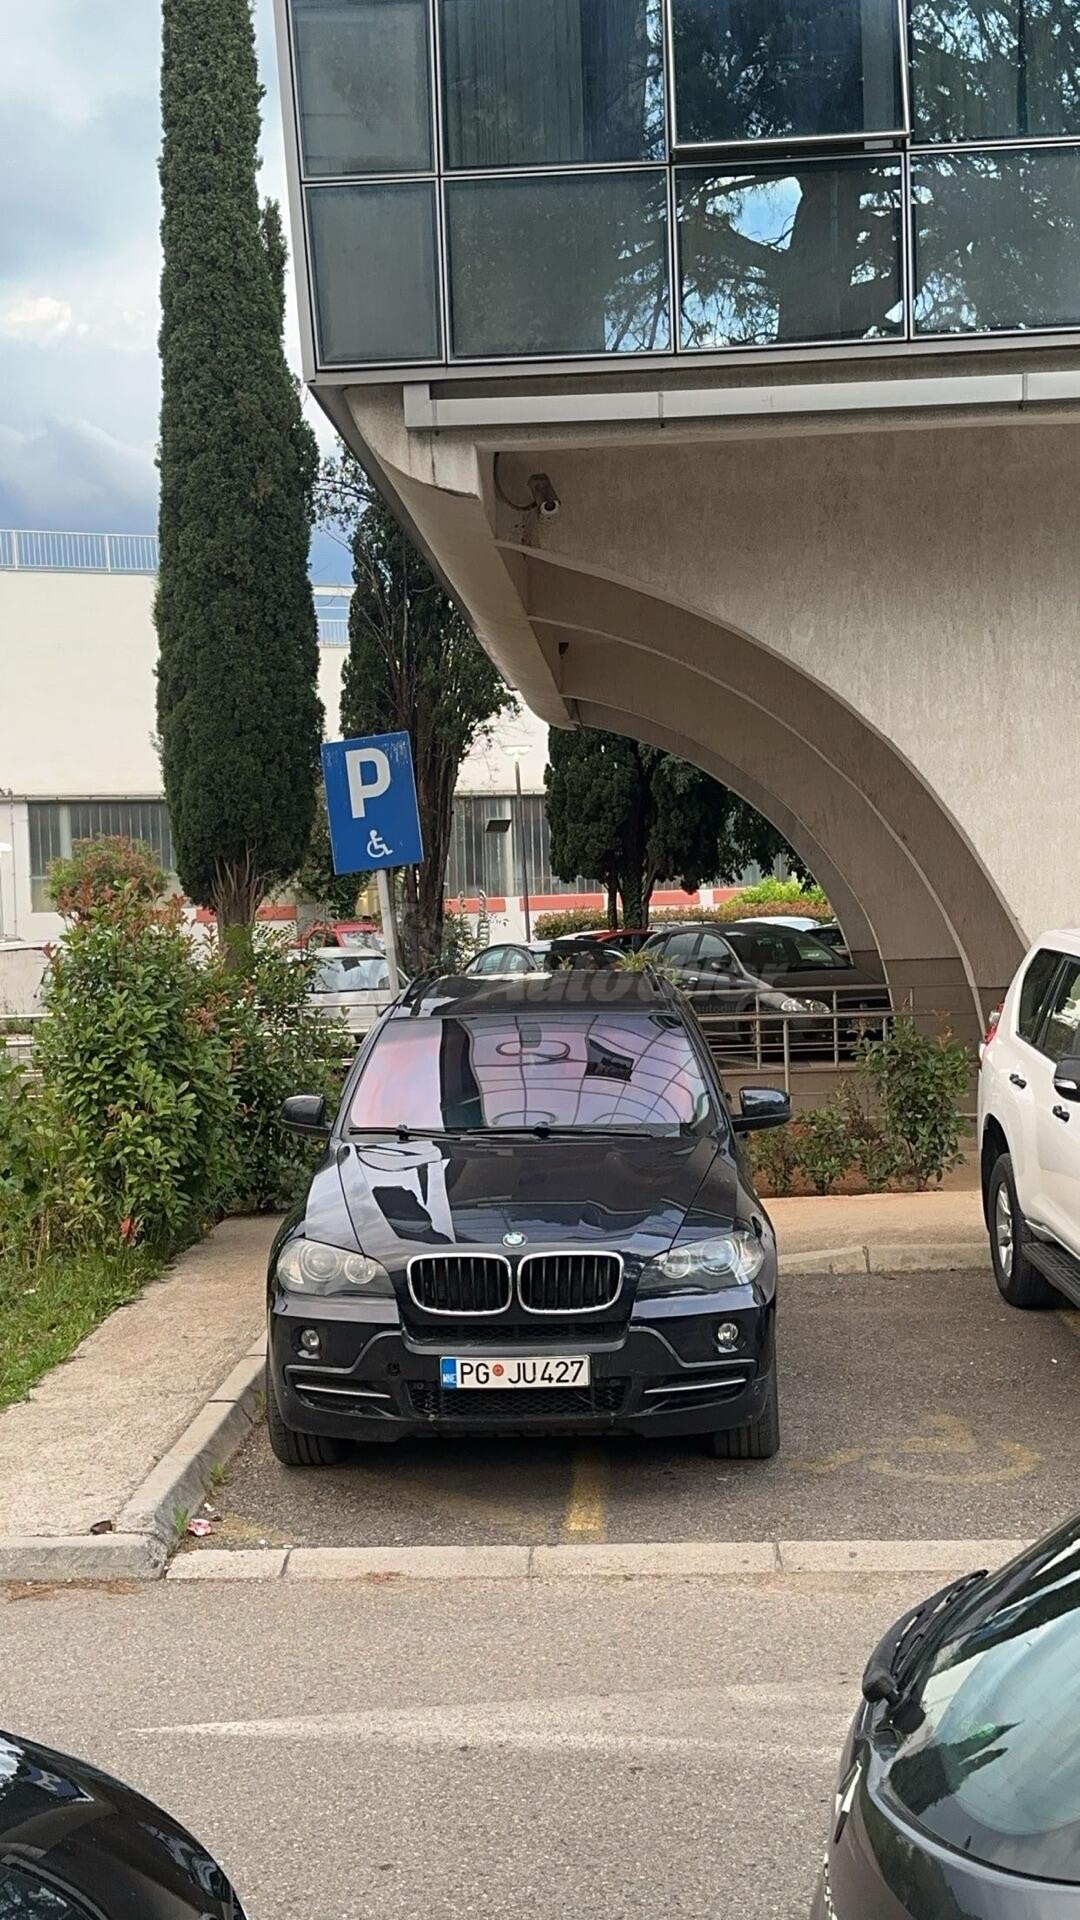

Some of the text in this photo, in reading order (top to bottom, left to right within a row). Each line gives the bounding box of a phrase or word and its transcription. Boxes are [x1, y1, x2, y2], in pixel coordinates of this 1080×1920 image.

[345, 747, 391, 819] P
[460, 1362, 490, 1384] PG
[508, 1360, 584, 1384] JU427
